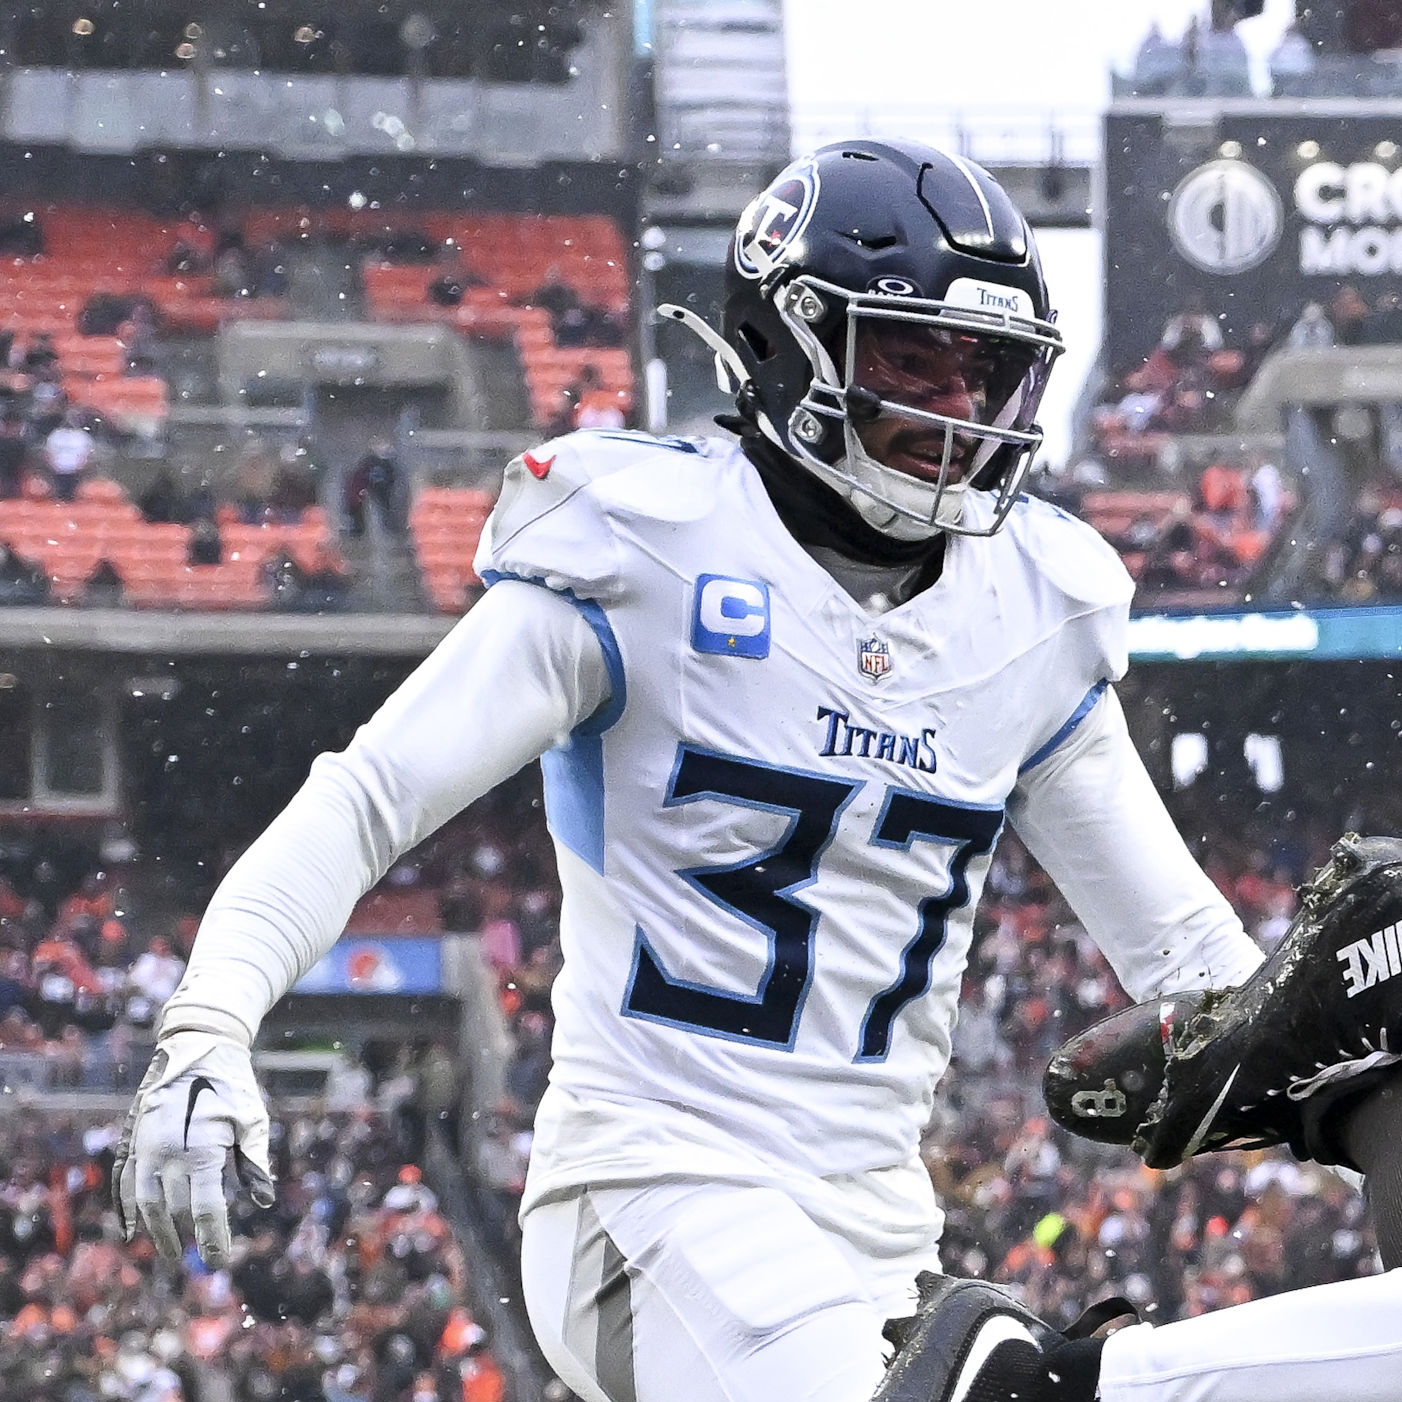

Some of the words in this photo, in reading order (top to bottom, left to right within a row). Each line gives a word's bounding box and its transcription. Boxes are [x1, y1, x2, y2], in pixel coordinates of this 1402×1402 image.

[977, 288, 1018, 312] TITANS
[700, 580, 766, 637] C
[864, 653, 889, 672] NFL
[817, 706, 937, 774] TITANS
[620, 741, 1006, 1064] 37
